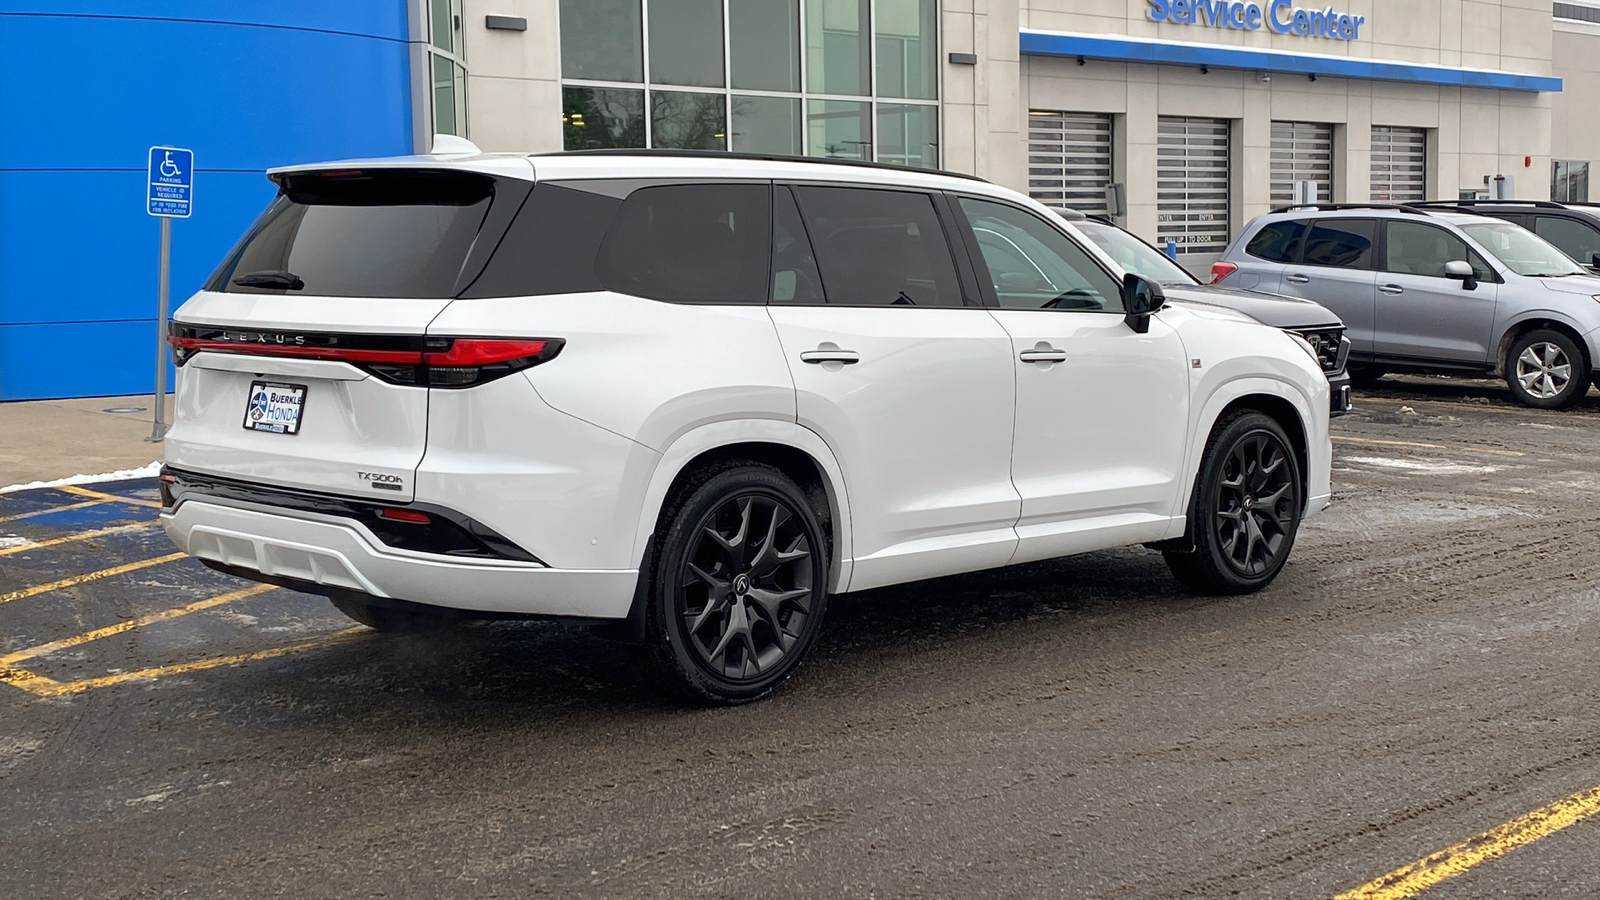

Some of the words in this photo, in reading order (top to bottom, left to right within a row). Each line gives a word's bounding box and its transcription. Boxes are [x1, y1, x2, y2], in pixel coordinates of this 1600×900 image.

[1146, 0, 1261, 30] Service
[1265, 0, 1364, 40] Center
[1189, 235, 1196, 243] TO
[1197, 235, 1212, 243] DOOR
[223, 331, 305, 345] LEXUS
[270, 392, 302, 405] BUERKLE
[266, 403, 299, 421] HONDA
